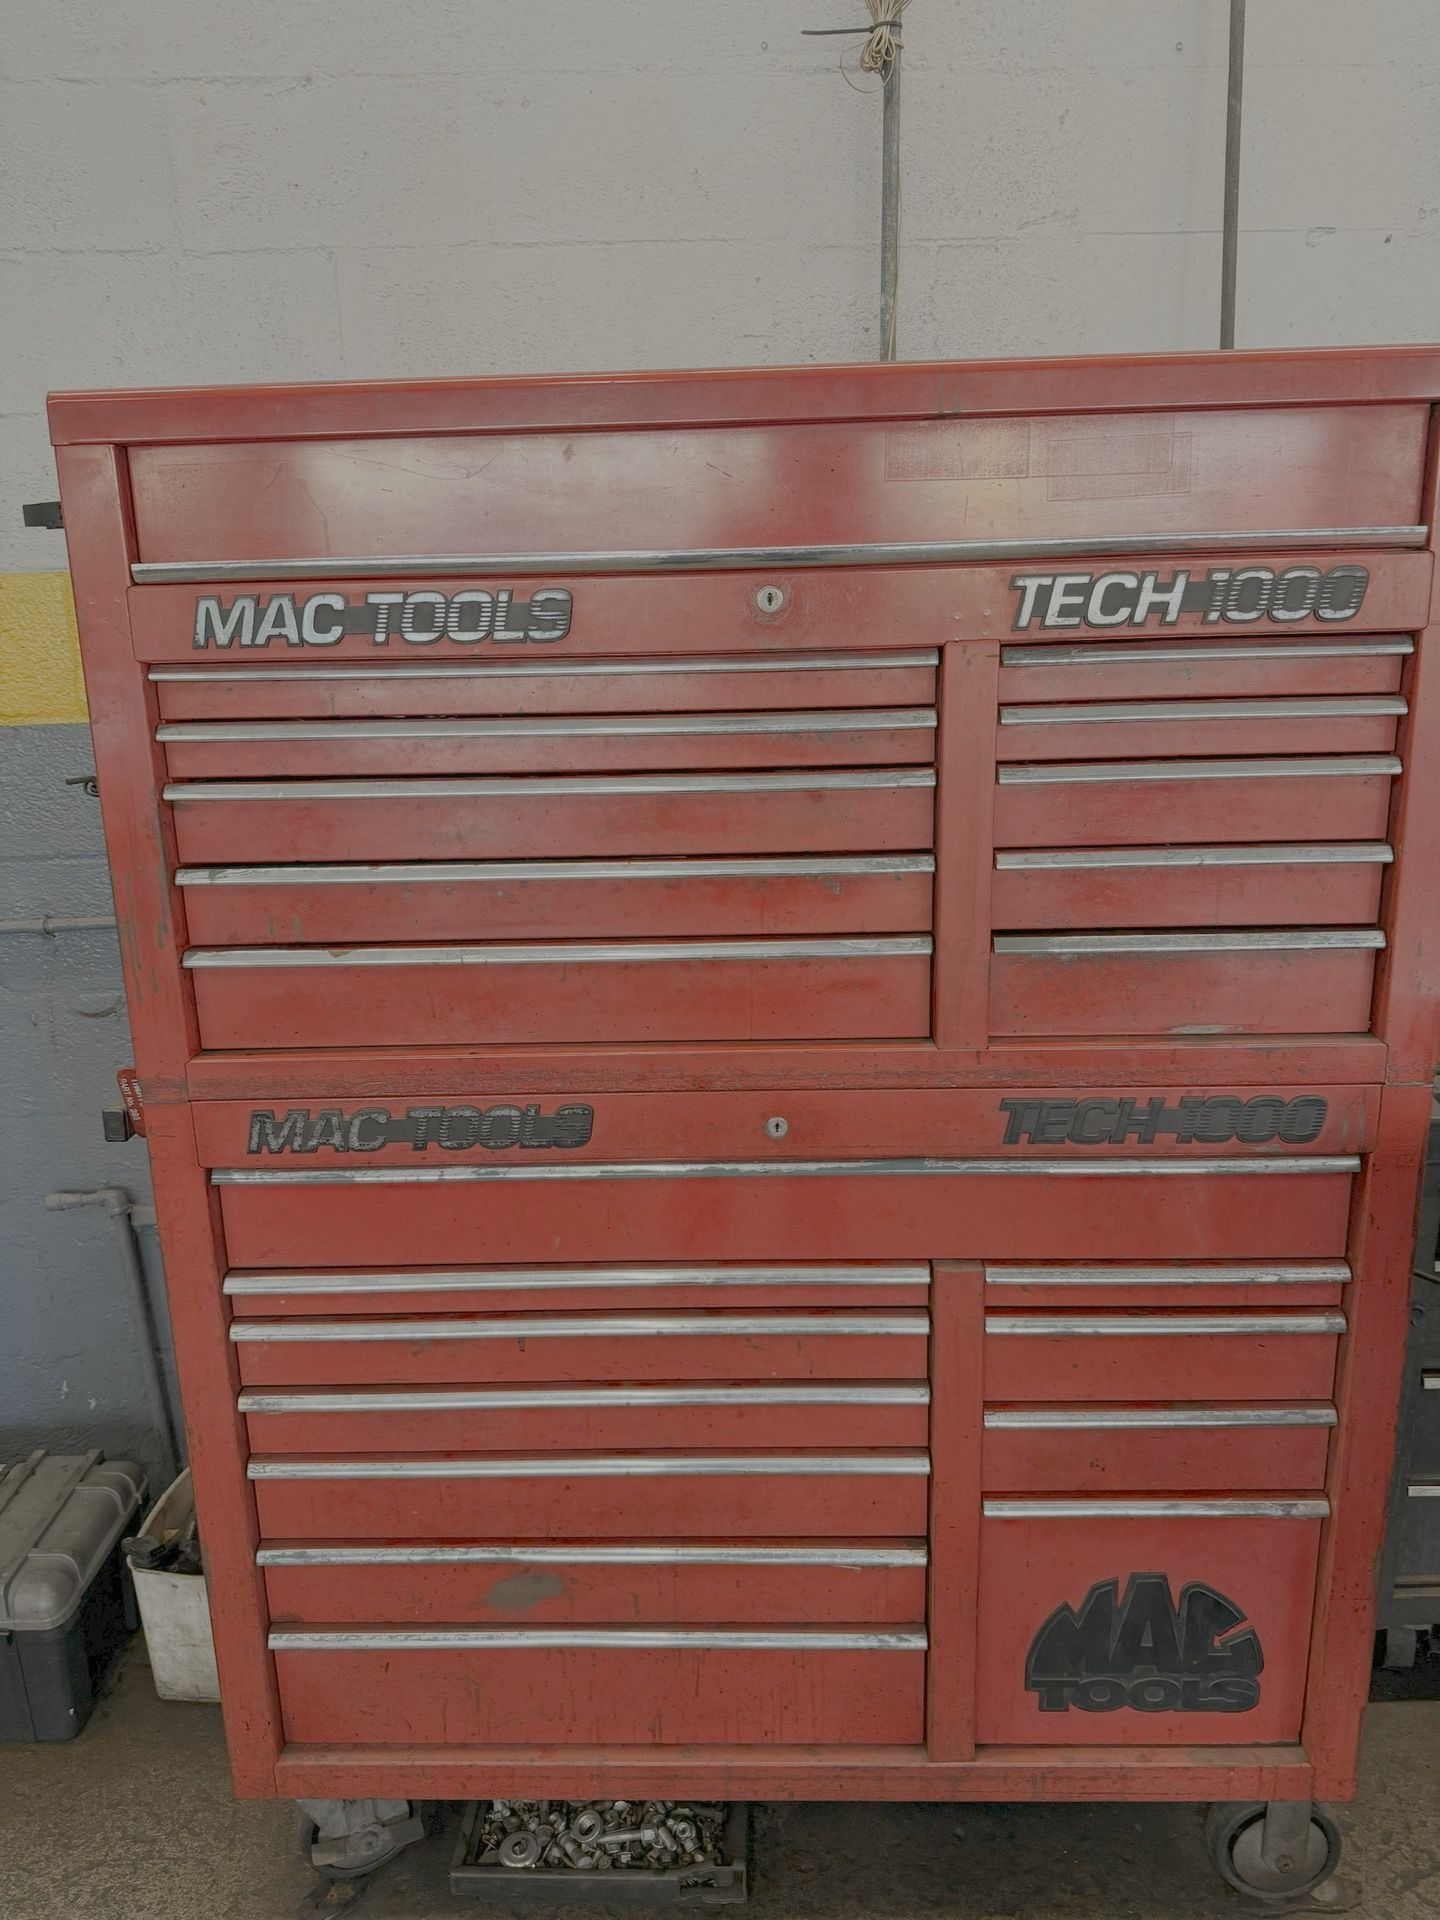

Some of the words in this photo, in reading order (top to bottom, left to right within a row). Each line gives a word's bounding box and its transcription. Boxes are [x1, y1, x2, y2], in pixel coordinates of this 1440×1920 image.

[193, 592, 345, 648] MAC
[367, 588, 573, 646] TOOLS
[1009, 570, 1191, 631] TECH
[1202, 565, 1369, 625] 1000
[247, 1108, 391, 1154] MAC
[407, 1103, 594, 1151] TOOLS
[1000, 1096, 1167, 1144] TECH
[1176, 1095, 1328, 1144] 1000
[1025, 1572, 1264, 1677] MAC
[1030, 1677, 1260, 1712] TOOLS
